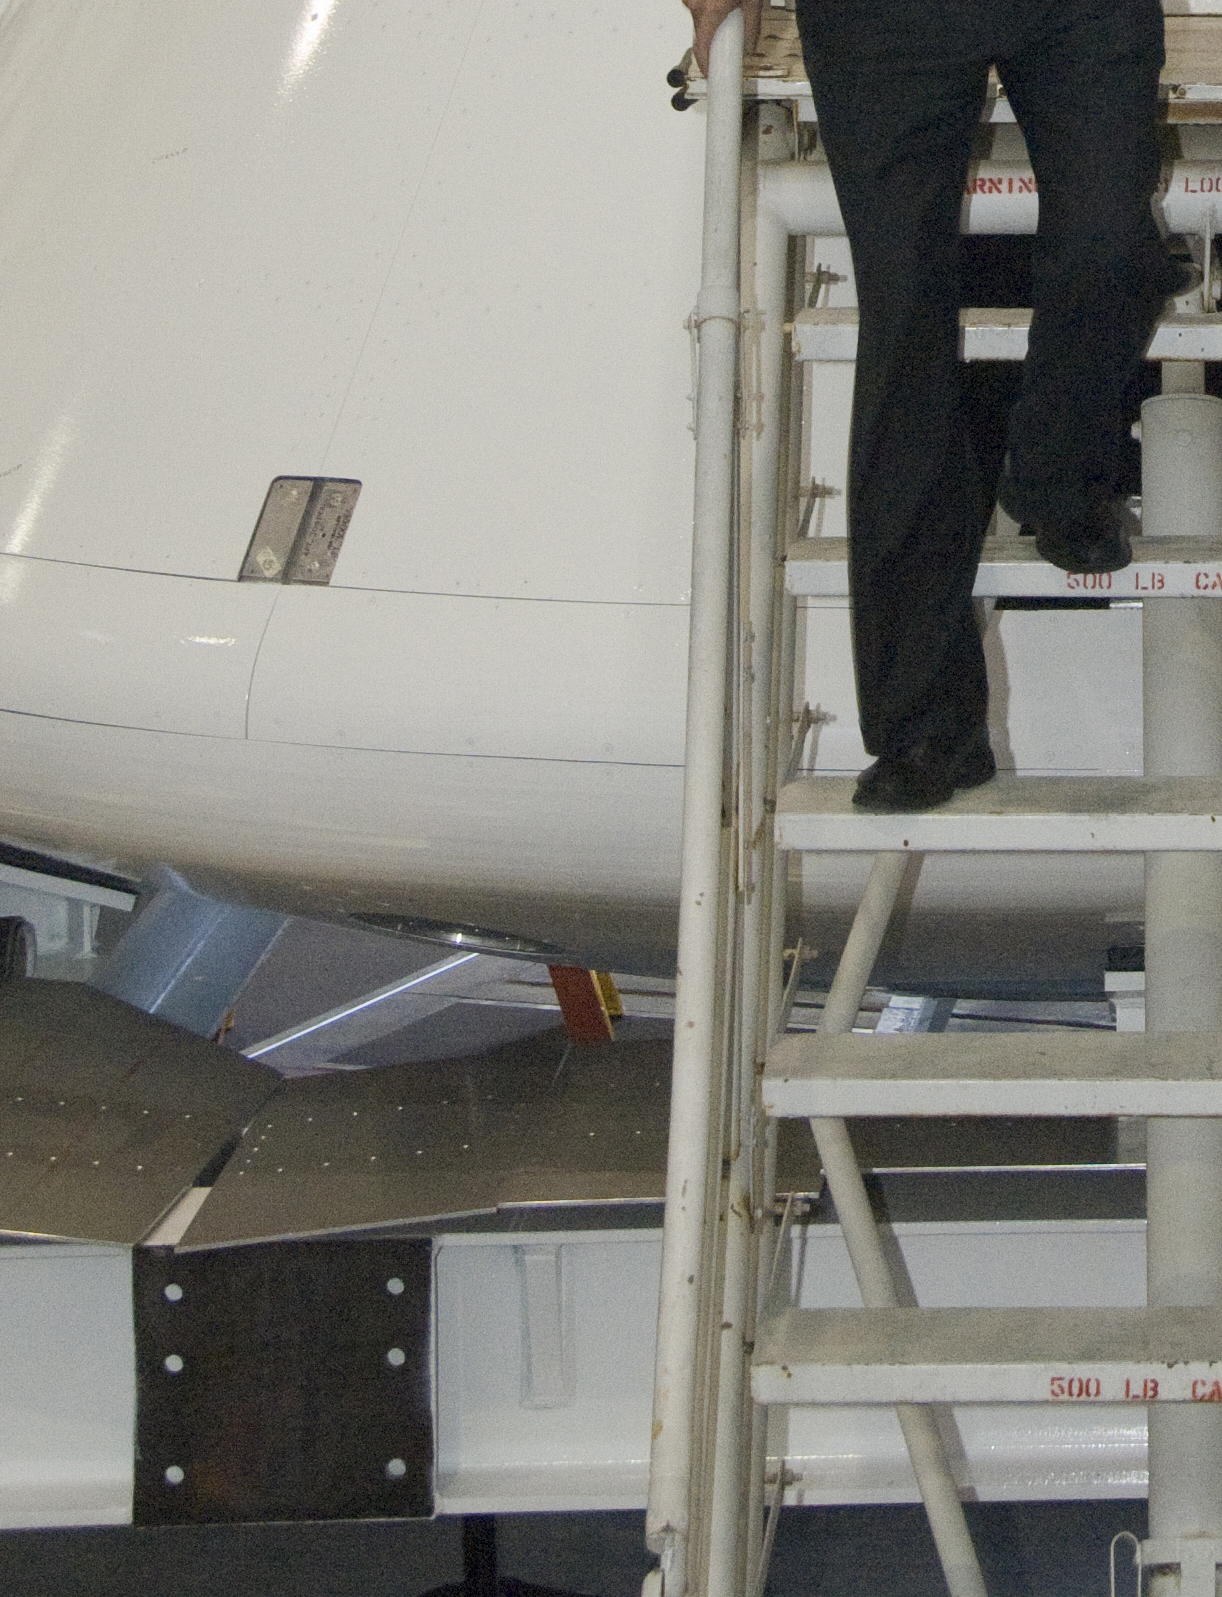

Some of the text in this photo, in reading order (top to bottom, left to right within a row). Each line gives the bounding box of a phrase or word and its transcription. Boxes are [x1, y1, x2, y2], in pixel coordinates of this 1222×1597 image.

[1066, 570, 1112, 590] 500
[1134, 571, 1165, 590] LB
[1050, 1376, 1100, 1398] 500
[1125, 1377, 1159, 1399] LB
